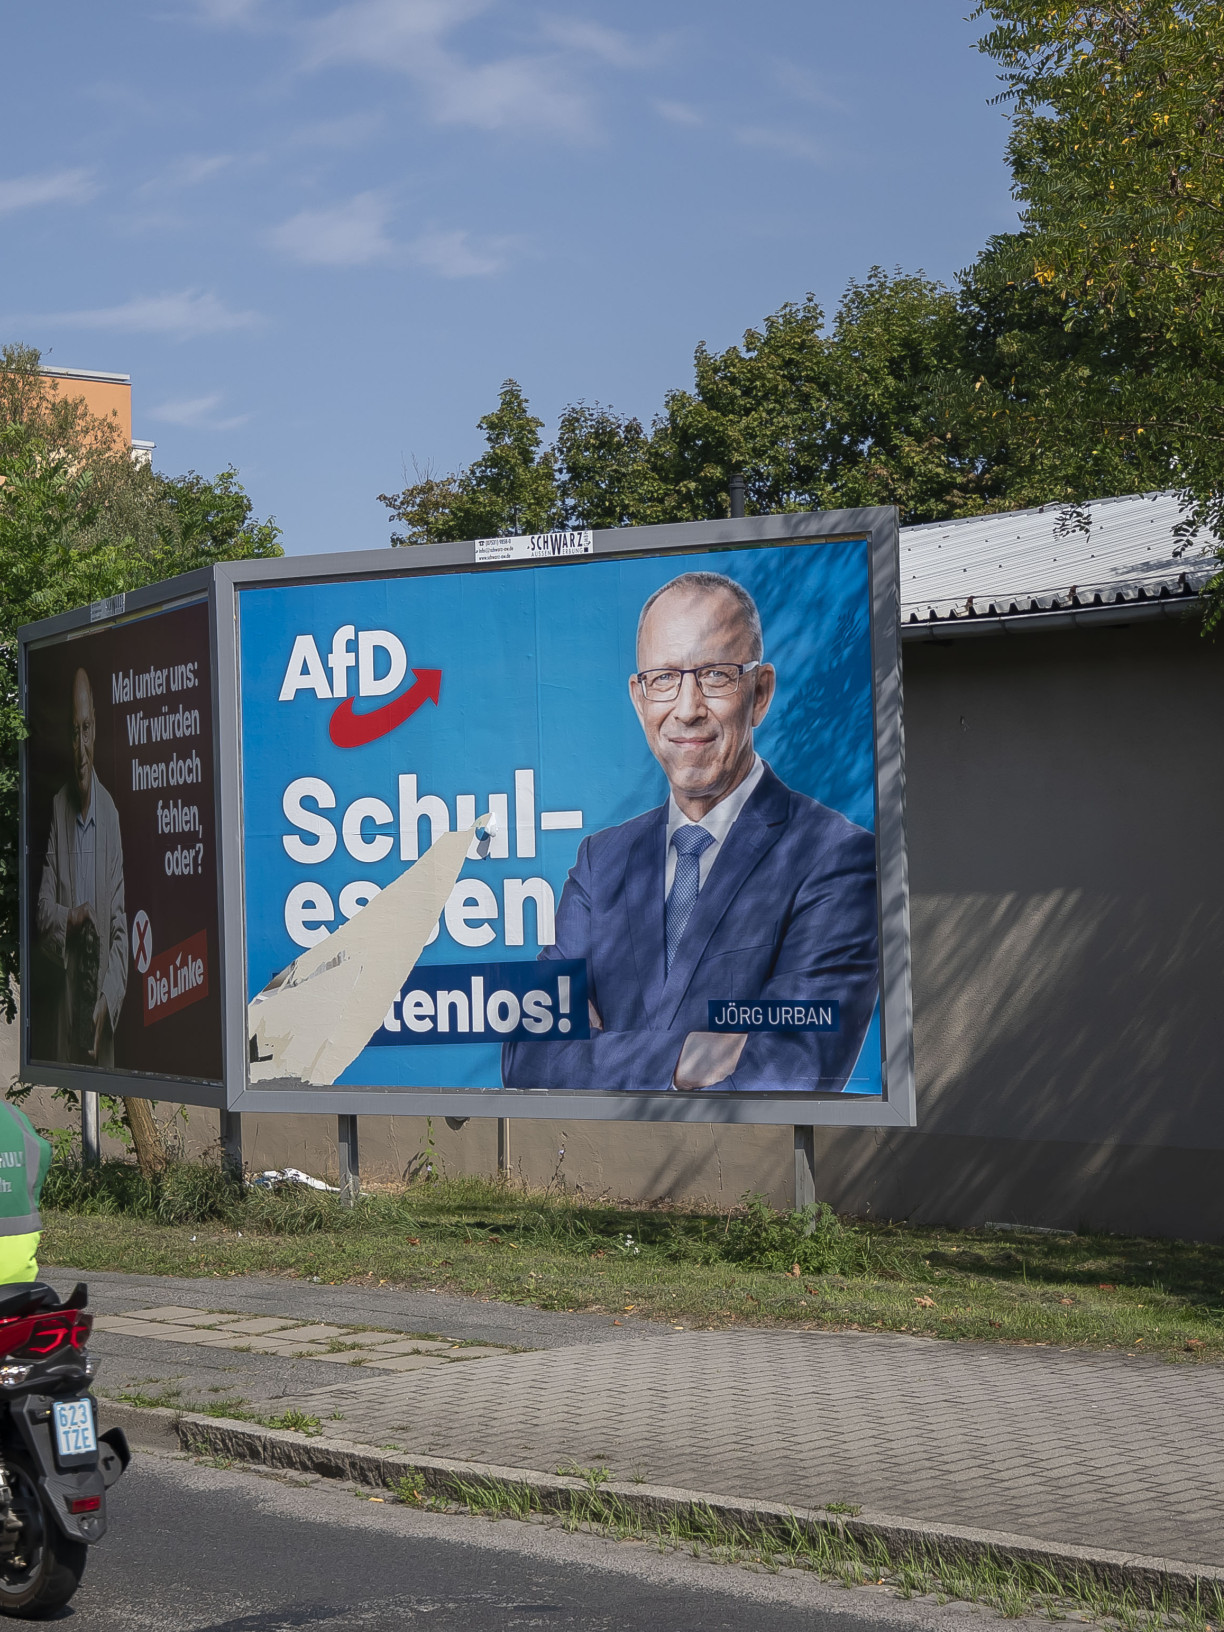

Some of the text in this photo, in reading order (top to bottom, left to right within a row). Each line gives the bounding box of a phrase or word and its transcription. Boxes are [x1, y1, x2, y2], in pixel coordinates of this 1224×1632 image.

[531, 532, 583, 555] SCHWARZ
[112, 661, 198, 704] Mal unter uns:
[278, 624, 407, 701] AfD
[126, 704, 200, 746] Wir würden
[132, 749, 202, 791] Ihnen doch
[157, 799, 203, 838] fehlen,
[282, 769, 583, 864] Schul-
[164, 843, 204, 876] oder?
[284, 877, 556, 949] esen
[147, 952, 204, 1010] Die Linke
[714, 1002, 832, 1025] JÖRG URBAN
[58, 1403, 88, 1427] 623
[62, 1427, 92, 1451] TZE
